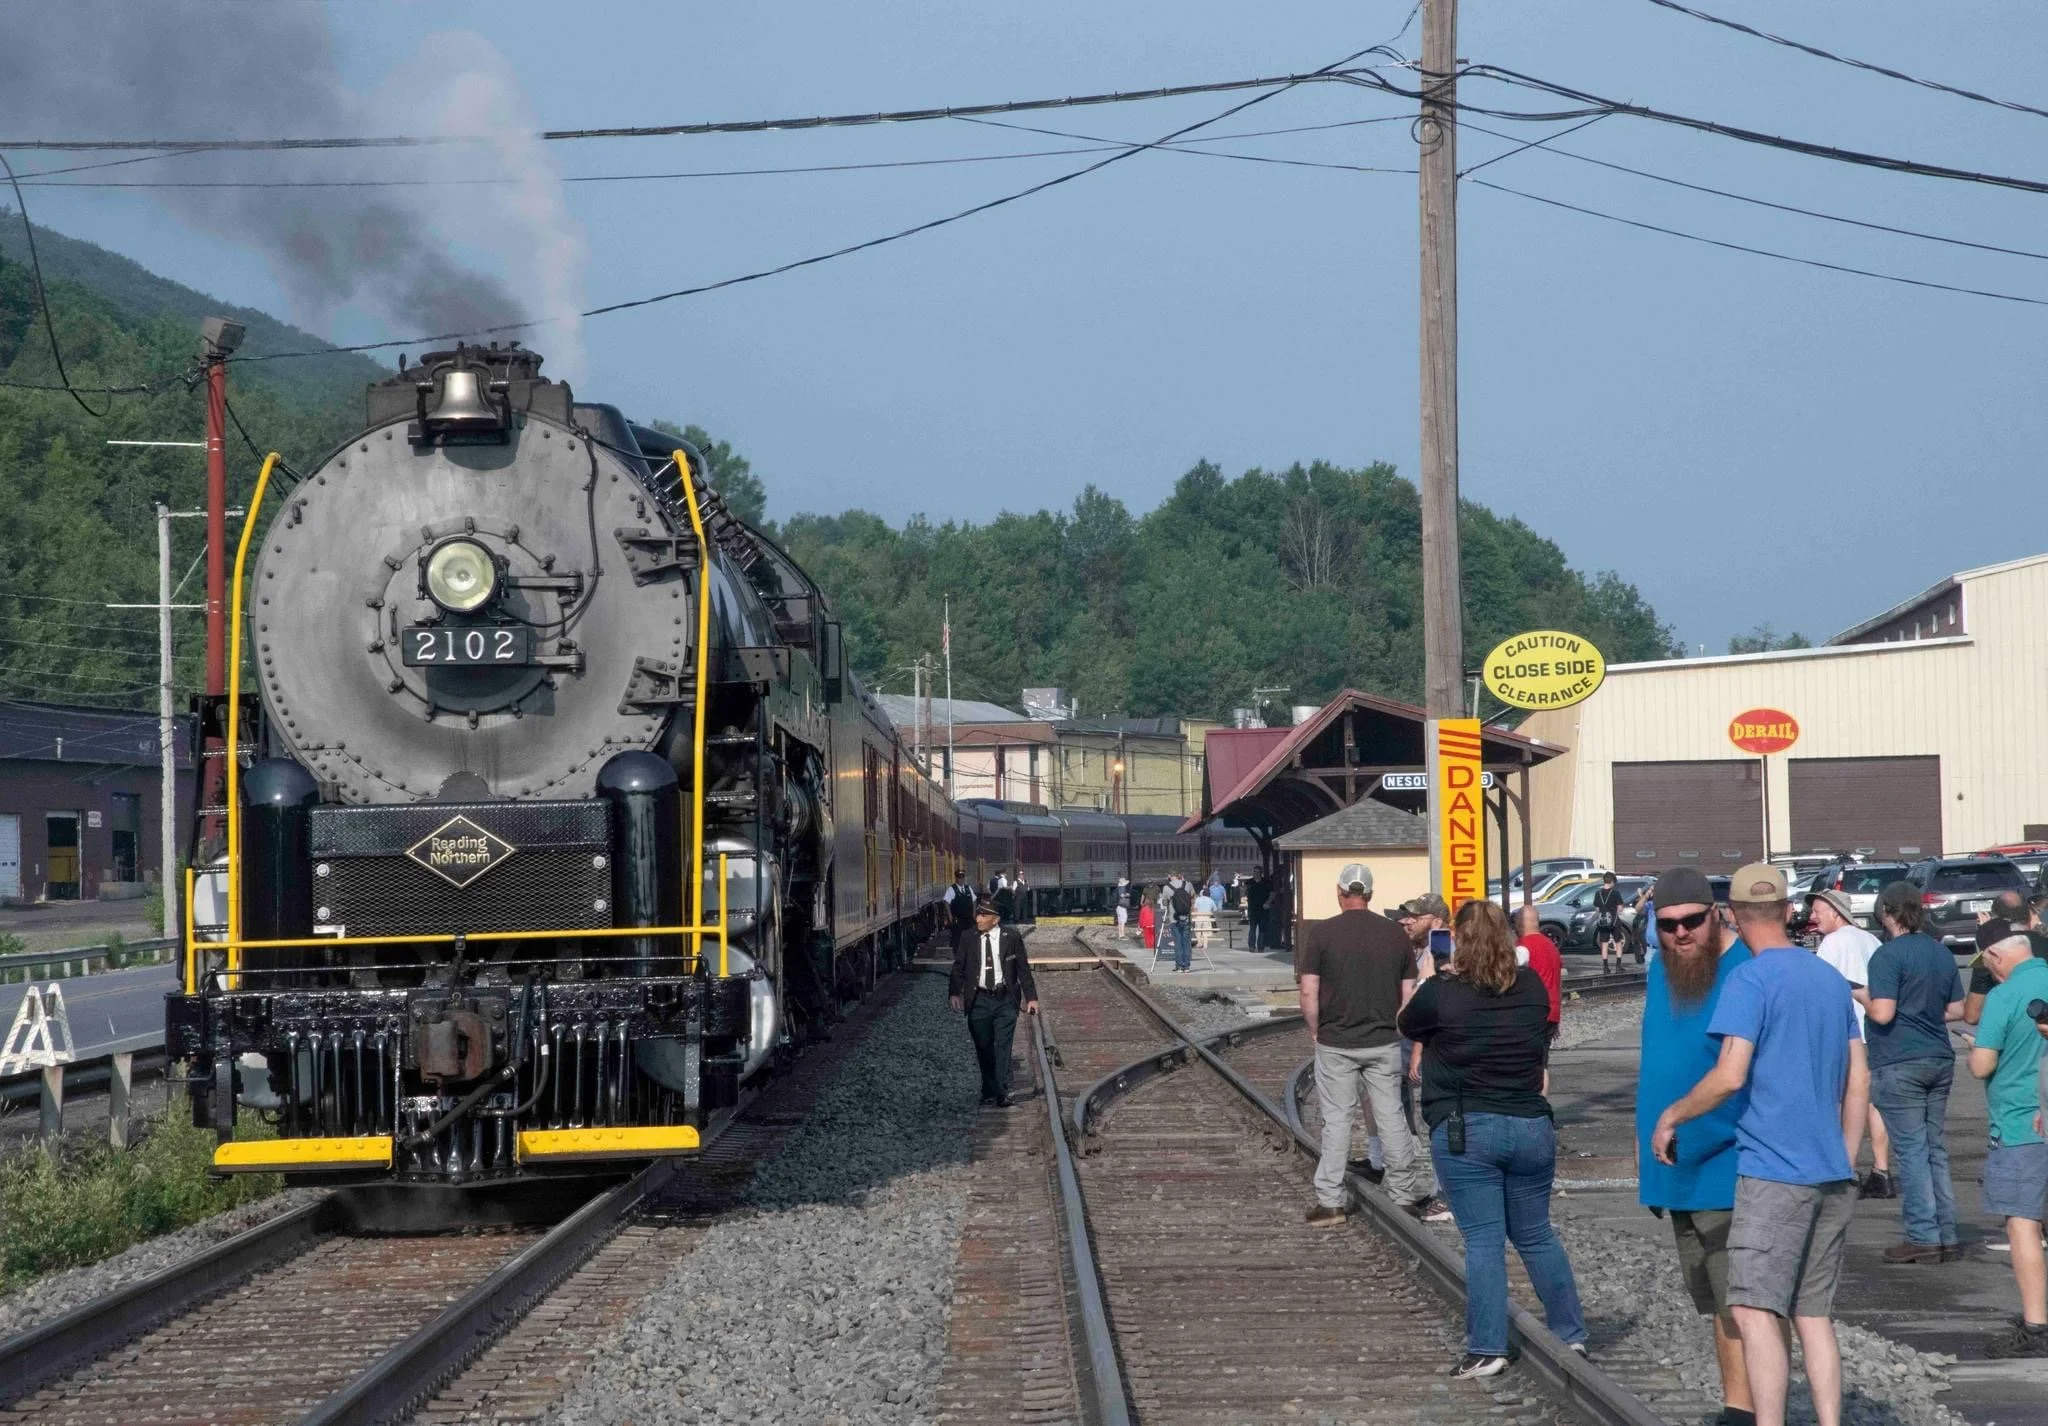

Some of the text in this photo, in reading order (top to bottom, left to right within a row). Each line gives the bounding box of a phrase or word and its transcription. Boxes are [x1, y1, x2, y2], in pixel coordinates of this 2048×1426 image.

[416, 631, 515, 661] 2102
[1504, 635, 1581, 658] CAUTION
[1493, 659, 1596, 680] CLOSE SIDE
[1497, 676, 1593, 705] CLEARANCE
[1732, 722, 1796, 741] DERAIL
[431, 835, 489, 853] Reading
[430, 852, 491, 865] Northern
